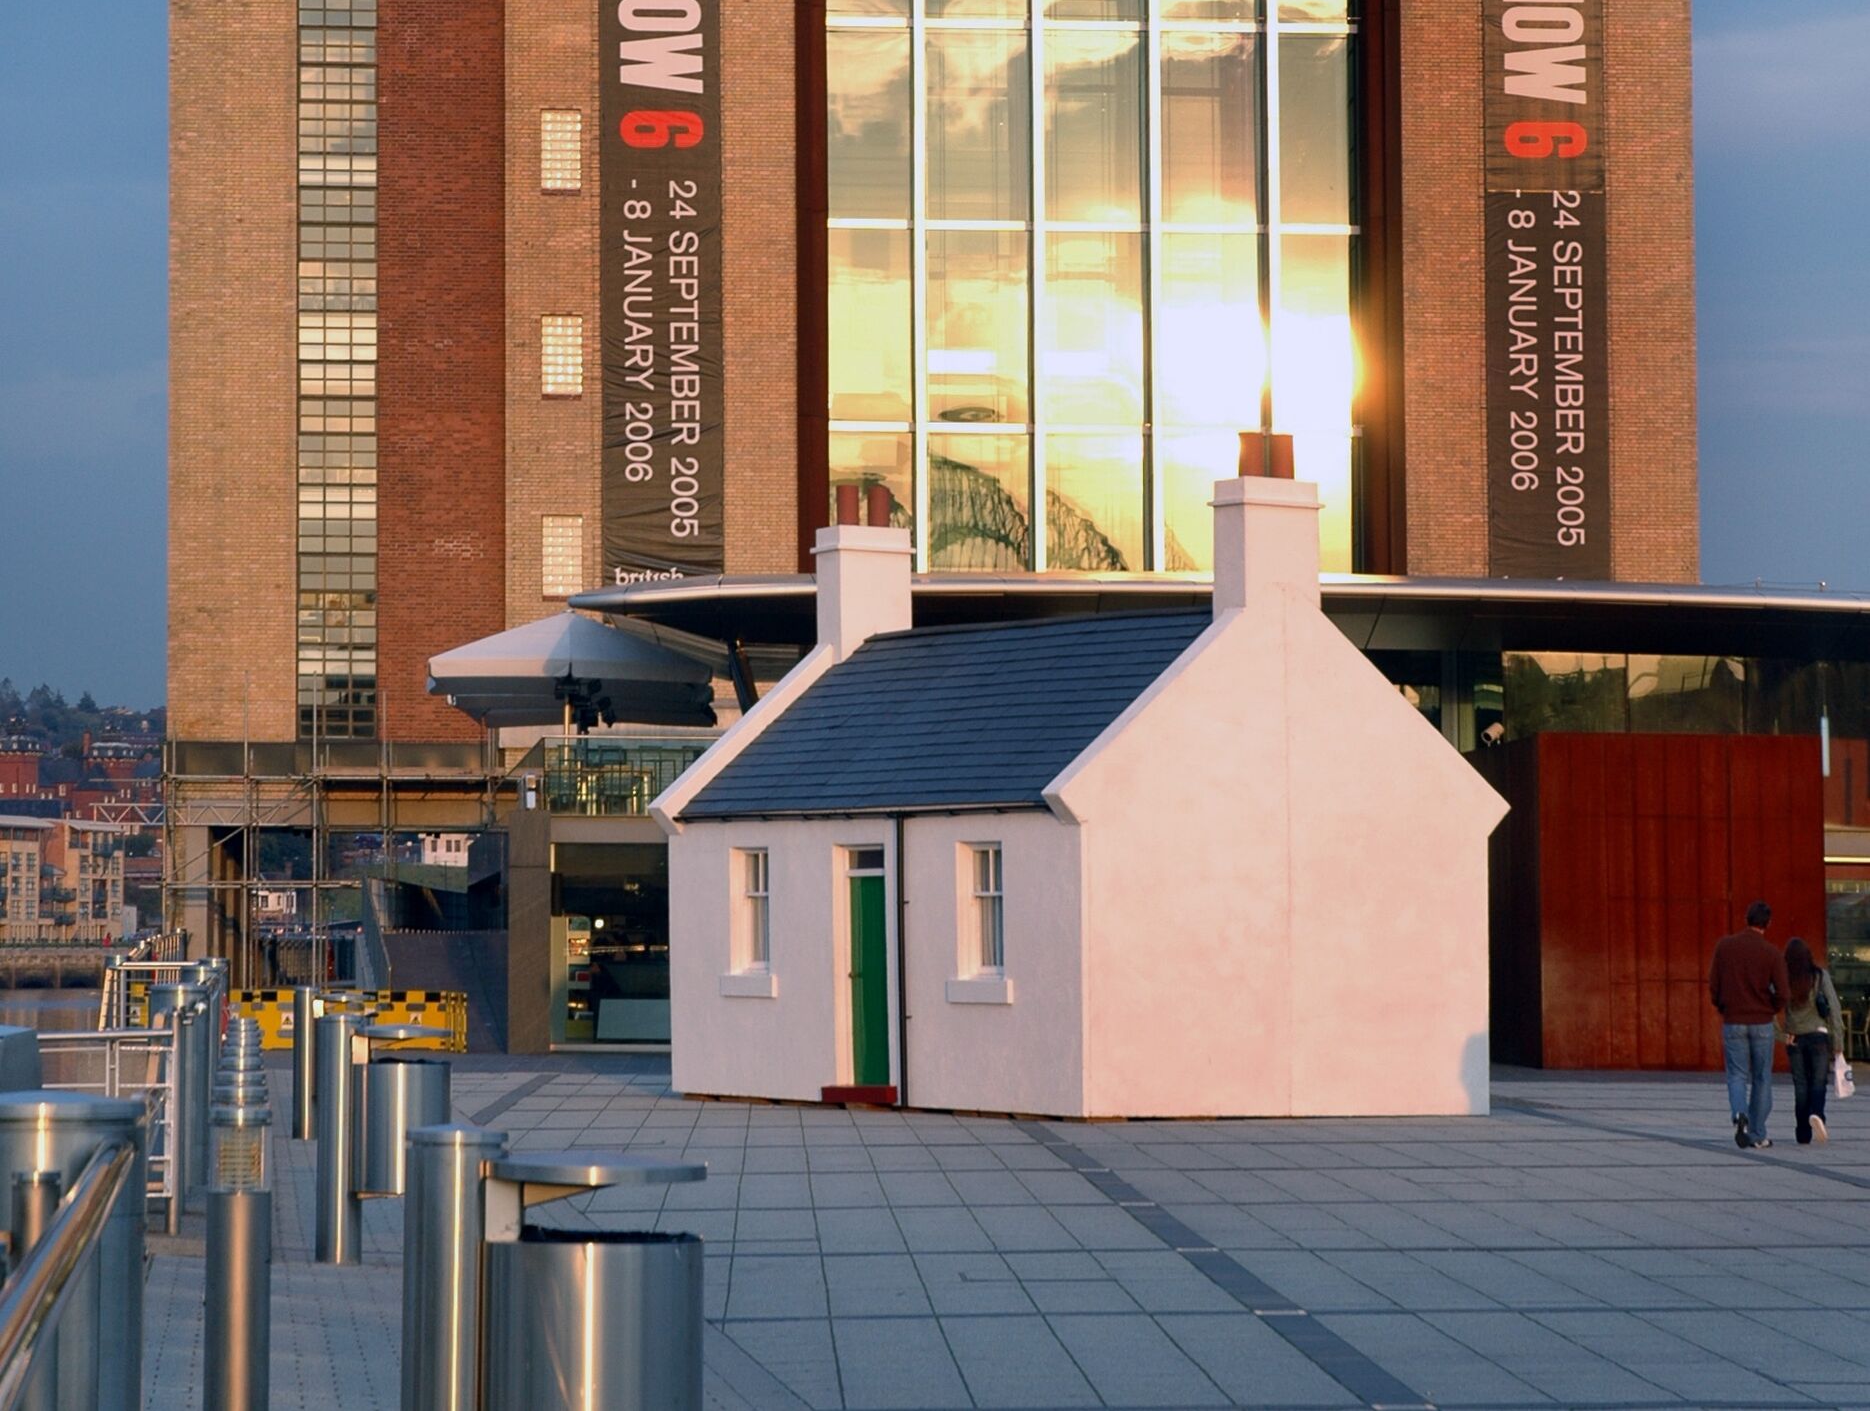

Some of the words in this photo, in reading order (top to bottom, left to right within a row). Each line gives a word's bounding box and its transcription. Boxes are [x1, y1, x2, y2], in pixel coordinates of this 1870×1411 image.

[620, 110, 704, 148] 6
[1504, 120, 1588, 158] 6
[623, 200, 652, 220] 8
[669, 180, 697, 219] 24
[1508, 209, 1536, 229] 8
[1553, 190, 1581, 228] 24
[623, 230, 655, 391] JANUARY
[669, 230, 700, 445] SEPTEMBER
[1507, 240, 1539, 399] JANUARY
[1553, 240, 1585, 454] SEPTEMBER
[625, 402, 654, 482] 2006
[1510, 411, 1539, 491] 2006
[670, 457, 699, 538] 2005
[1556, 466, 1585, 546] 2005
